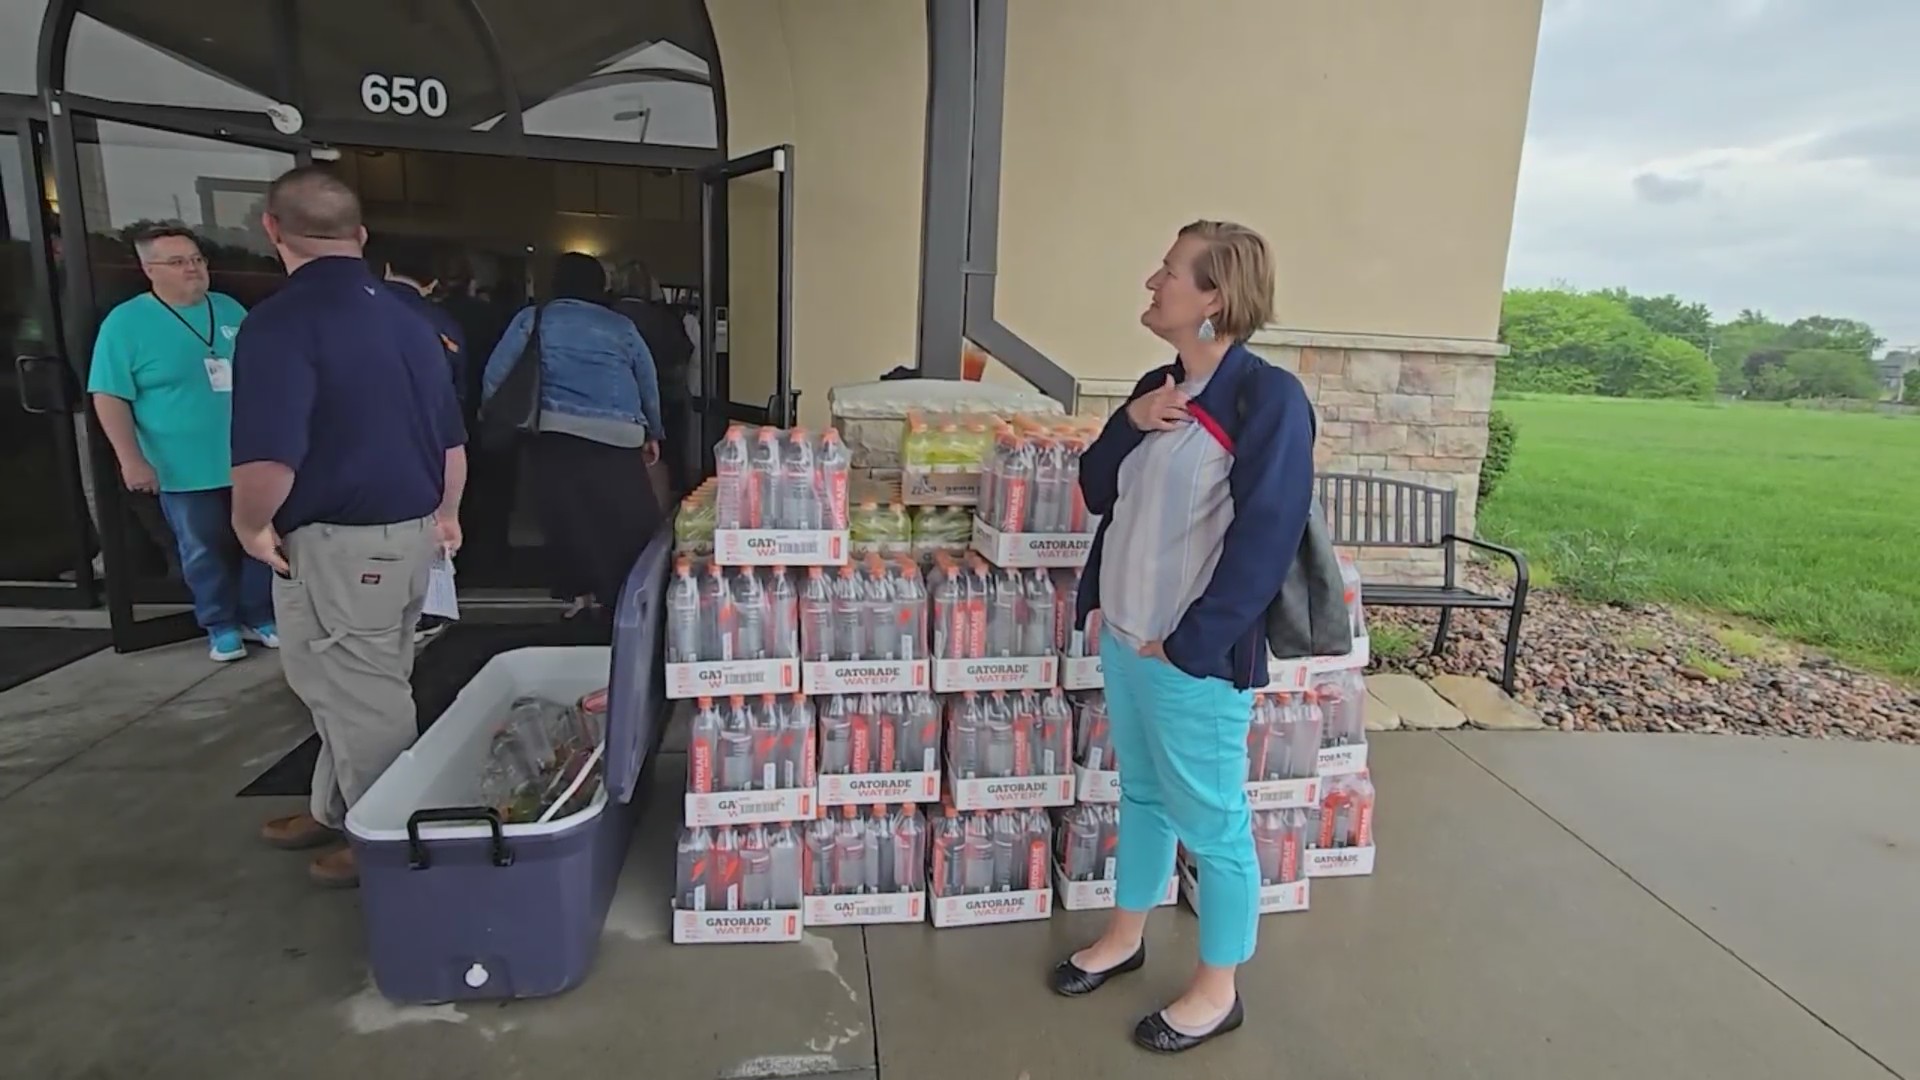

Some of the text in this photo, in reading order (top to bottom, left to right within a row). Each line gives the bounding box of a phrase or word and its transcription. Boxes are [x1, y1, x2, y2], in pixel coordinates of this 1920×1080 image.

[361, 74, 448, 118] 650
[1029, 540, 1090, 550] GATORADE
[835, 667, 900, 678] GATORADE
[967, 664, 1029, 675] GATORADE
[849, 779, 913, 790] GATORADE
[987, 782, 1048, 793] GATORADE
[965, 898, 1025, 909] GATORADE
[706, 917, 771, 927] GATORADE
